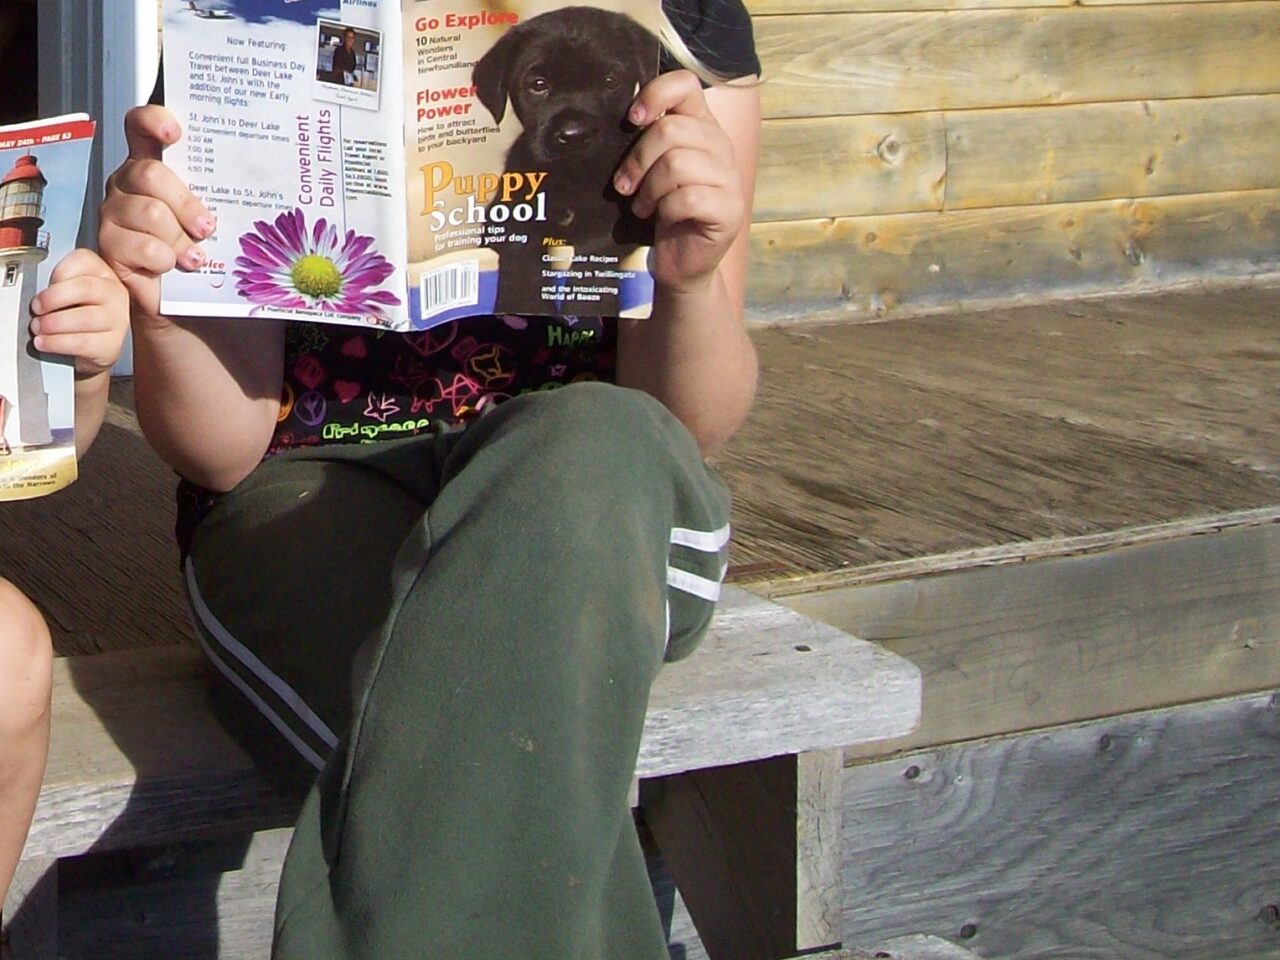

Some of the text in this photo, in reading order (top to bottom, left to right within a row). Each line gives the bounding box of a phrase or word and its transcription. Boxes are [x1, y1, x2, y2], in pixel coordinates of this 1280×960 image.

[415, 11, 519, 32] Go Explore
[227, 37, 244, 46] Now
[416, 34, 461, 46] 10 Natural
[417, 45, 453, 56] Wonders
[427, 53, 457, 63] Central
[189, 51, 305, 72] Convenient full Business Day
[418, 60, 479, 74] Newfoundland
[190, 62, 293, 80] Travel between Deer Lake
[190, 73, 204, 81] and
[220, 76, 243, 85] John's
[247, 79, 265, 88] with
[268, 81, 280, 89] the
[190, 83, 289, 103] addition of our new Early
[190, 93, 221, 106] morning
[417, 86, 477, 105] Flower
[417, 103, 472, 122] Power
[202, 114, 225, 123] John's
[228, 116, 236, 125] to
[239, 118, 258, 128] Deer
[261, 121, 280, 131] Lake
[447, 120, 476, 128] attract
[438, 130, 454, 138] and
[456, 127, 501, 136] butterflies
[0, 140, 15, 149] MAY
[427, 141, 444, 152] your
[446, 136, 487, 146] backyard
[296, 114, 313, 205] Convenient
[317, 109, 337, 207] Daily Flights
[189, 184, 208, 193] Deer
[211, 185, 230, 195] Lake
[233, 187, 242, 196] to
[259, 190, 283, 200] John's
[420, 160, 548, 216] Puppy
[430, 192, 547, 232] School
[487, 225, 505, 235] tips
[447, 237, 482, 248] training
[484, 236, 506, 245] your
[508, 233, 528, 243] dog
[542, 237, 566, 246] Plus:
[589, 255, 618, 264] Recipes
[542, 270, 583, 279] Stargazing
[584, 270, 592, 278] in
[573, 286, 619, 295] Intoxicating
